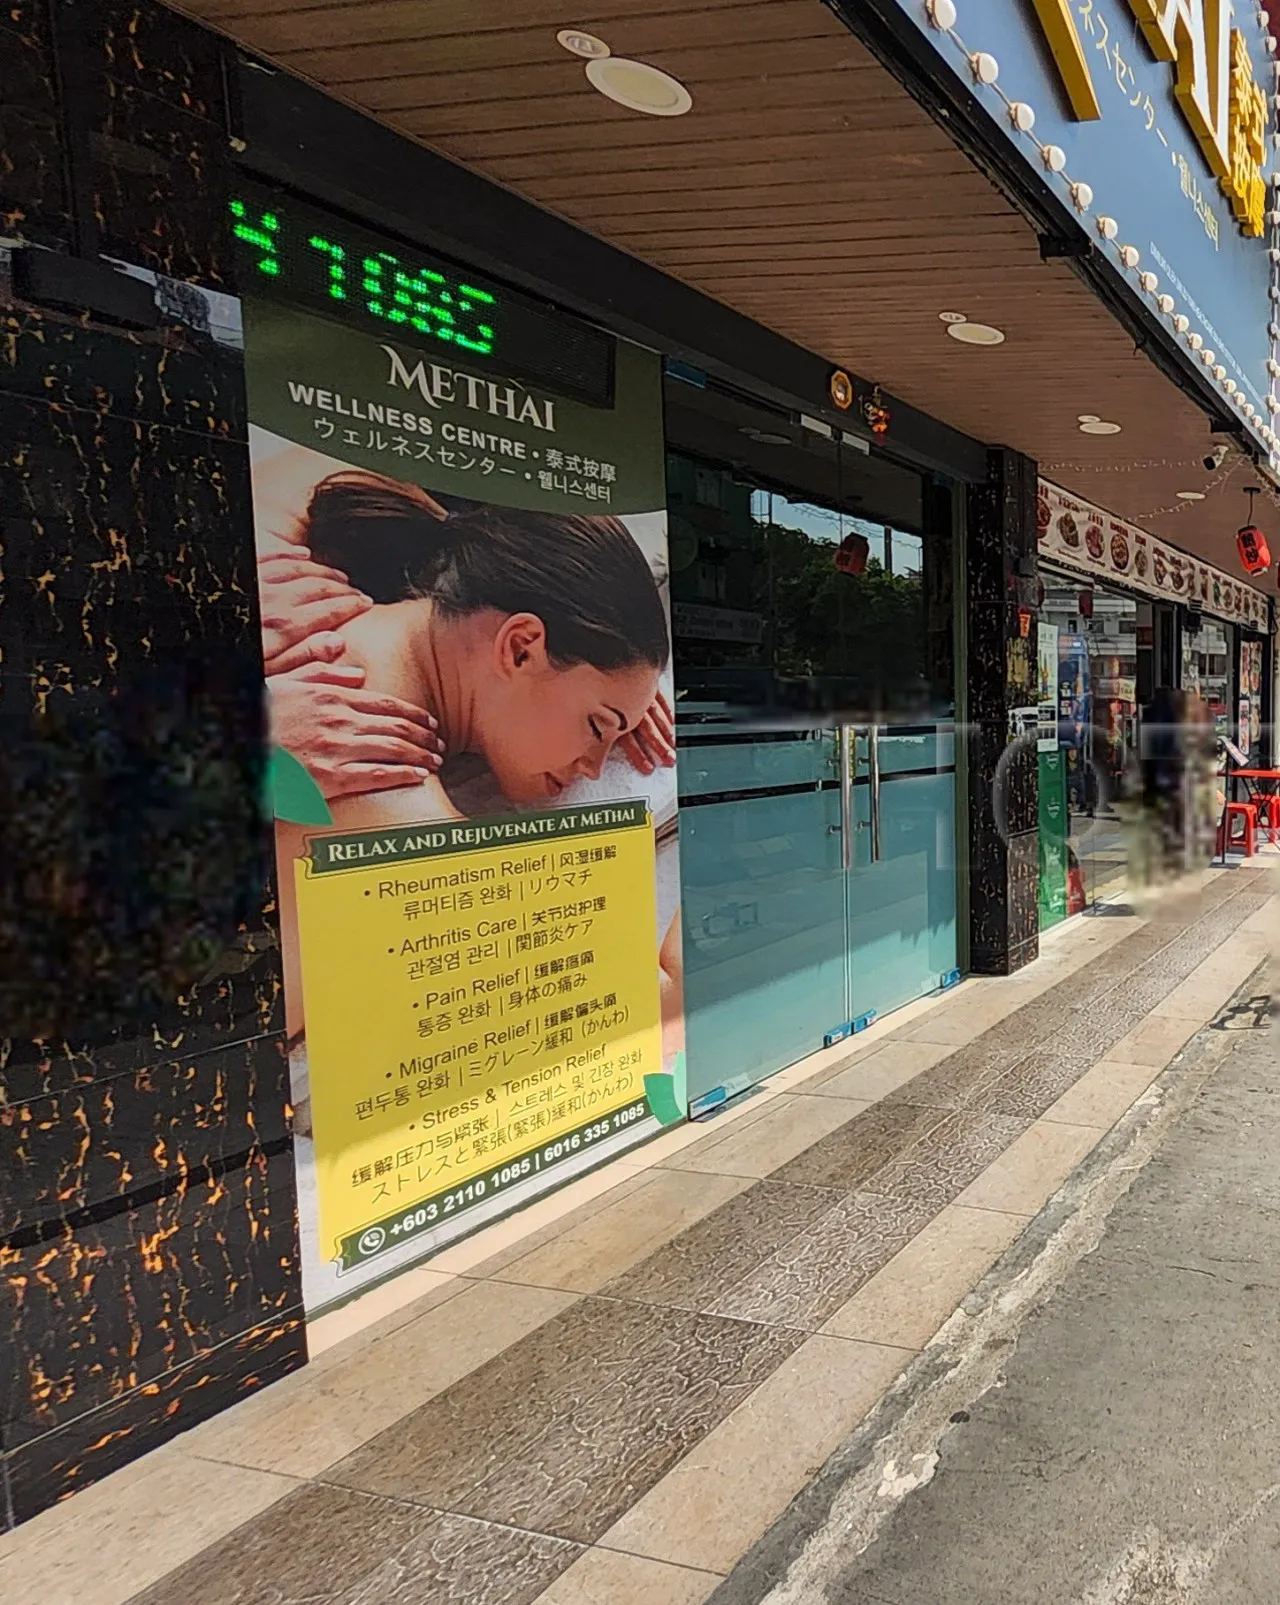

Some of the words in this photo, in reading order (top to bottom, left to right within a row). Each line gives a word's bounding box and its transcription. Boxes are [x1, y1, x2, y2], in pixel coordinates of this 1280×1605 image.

[288, 381, 433, 435] WELLNESS
[441, 423, 526, 460] CENTRE
[545, 448, 617, 483] 泰式按摩
[313, 416, 516, 476] ウェルネスセンター
[536, 470, 612, 504] 웰니스센터
[327, 838, 398, 863] RELAX
[403, 833, 447, 852] AND
[451, 818, 556, 845] REJUVENATE
[558, 816, 577, 830] AT
[378, 866, 496, 899] Rheumatism
[501, 855, 547, 877] Relief
[402, 889, 475, 921] 류머티즘
[479, 883, 513, 905] 완화
[530, 869, 593, 895] リウマチ
[399, 928, 472, 957] Arthritis
[476, 917, 518, 938] Care
[532, 896, 607, 927] 关节炎护理
[407, 950, 461, 980] 관절염
[466, 940, 500, 965] 관리
[515, 919, 594, 953] 関節炎ケア
[417, 1011, 453, 1039] 통증
[457, 999, 492, 1025] 완화
[508, 972, 588, 1011] 身体の痛み
[426, 987, 467, 1010] Pain
[472, 968, 521, 996] Relief
[399, 1039, 479, 1079] Migraine
[483, 1022, 532, 1050] Relief
[355, 1089, 410, 1121] 편두통
[416, 1071, 451, 1098] 완화
[422, 1097, 480, 1131] Stress
[485, 1088, 498, 1103] &
[500, 1063, 562, 1094] Tension
[565, 1043, 608, 1069] Relief
[508, 1085, 568, 1117] 스트레스
[571, 1073, 585, 1089] 및
[589, 1062, 614, 1083] 긴장
[617, 1050, 644, 1070] 완화
[389, 1206, 439, 1237] +603
[442, 1180, 486, 1214] 2110
[490, 1158, 532, 1188] 1085
[543, 1135, 582, 1161] 6016
[583, 1118, 611, 1143] 335
[611, 1102, 646, 1129] 1085
